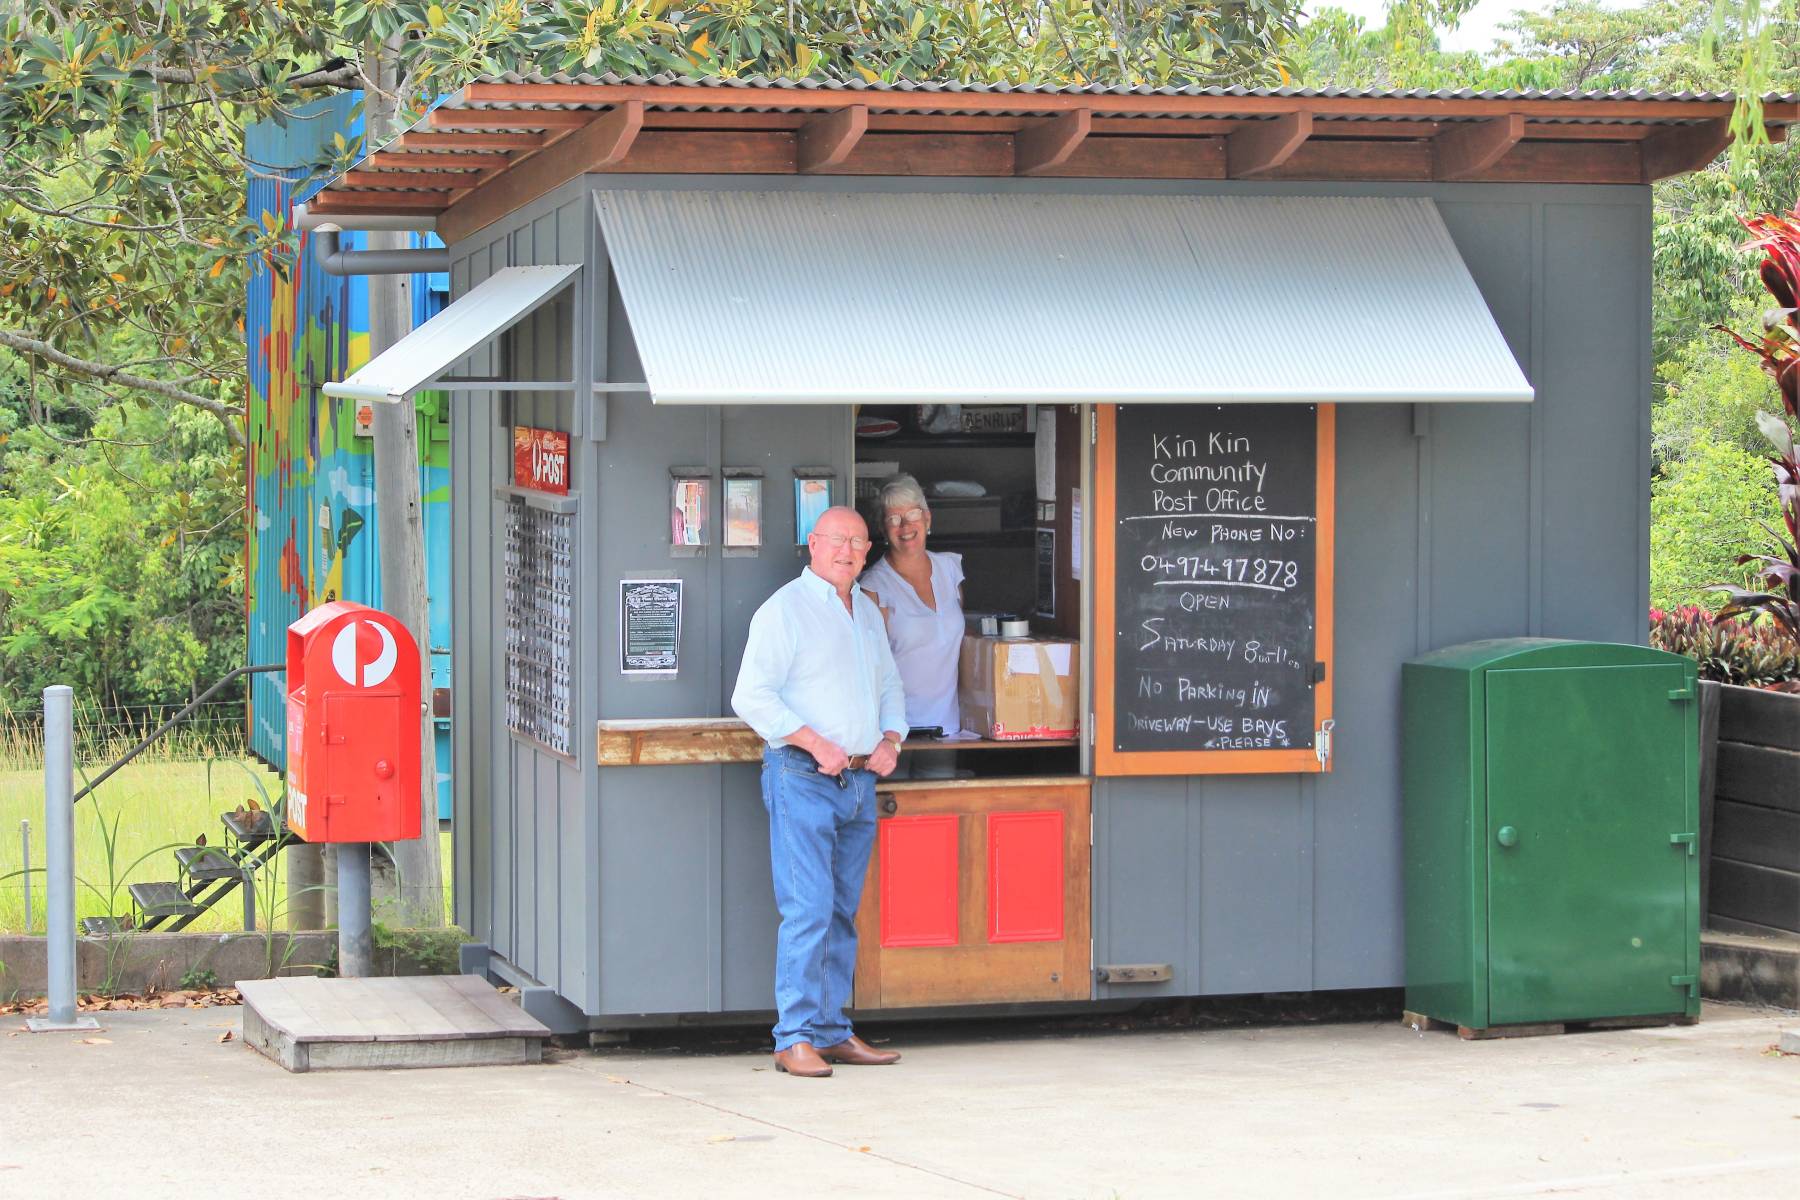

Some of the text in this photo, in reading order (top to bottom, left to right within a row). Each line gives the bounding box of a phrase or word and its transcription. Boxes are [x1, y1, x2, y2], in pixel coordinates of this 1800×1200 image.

[1153, 432, 1250, 459] Kin Kin
[542, 452, 565, 486] POST
[1150, 460, 1267, 492] Community
[1152, 488, 1267, 512] Post Office
[1211, 524, 1263, 544] PHONE
[1179, 592, 1230, 612] OPEN
[1242, 717, 1287, 739] BAYS
[1220, 736, 1271, 750] PLEASE
